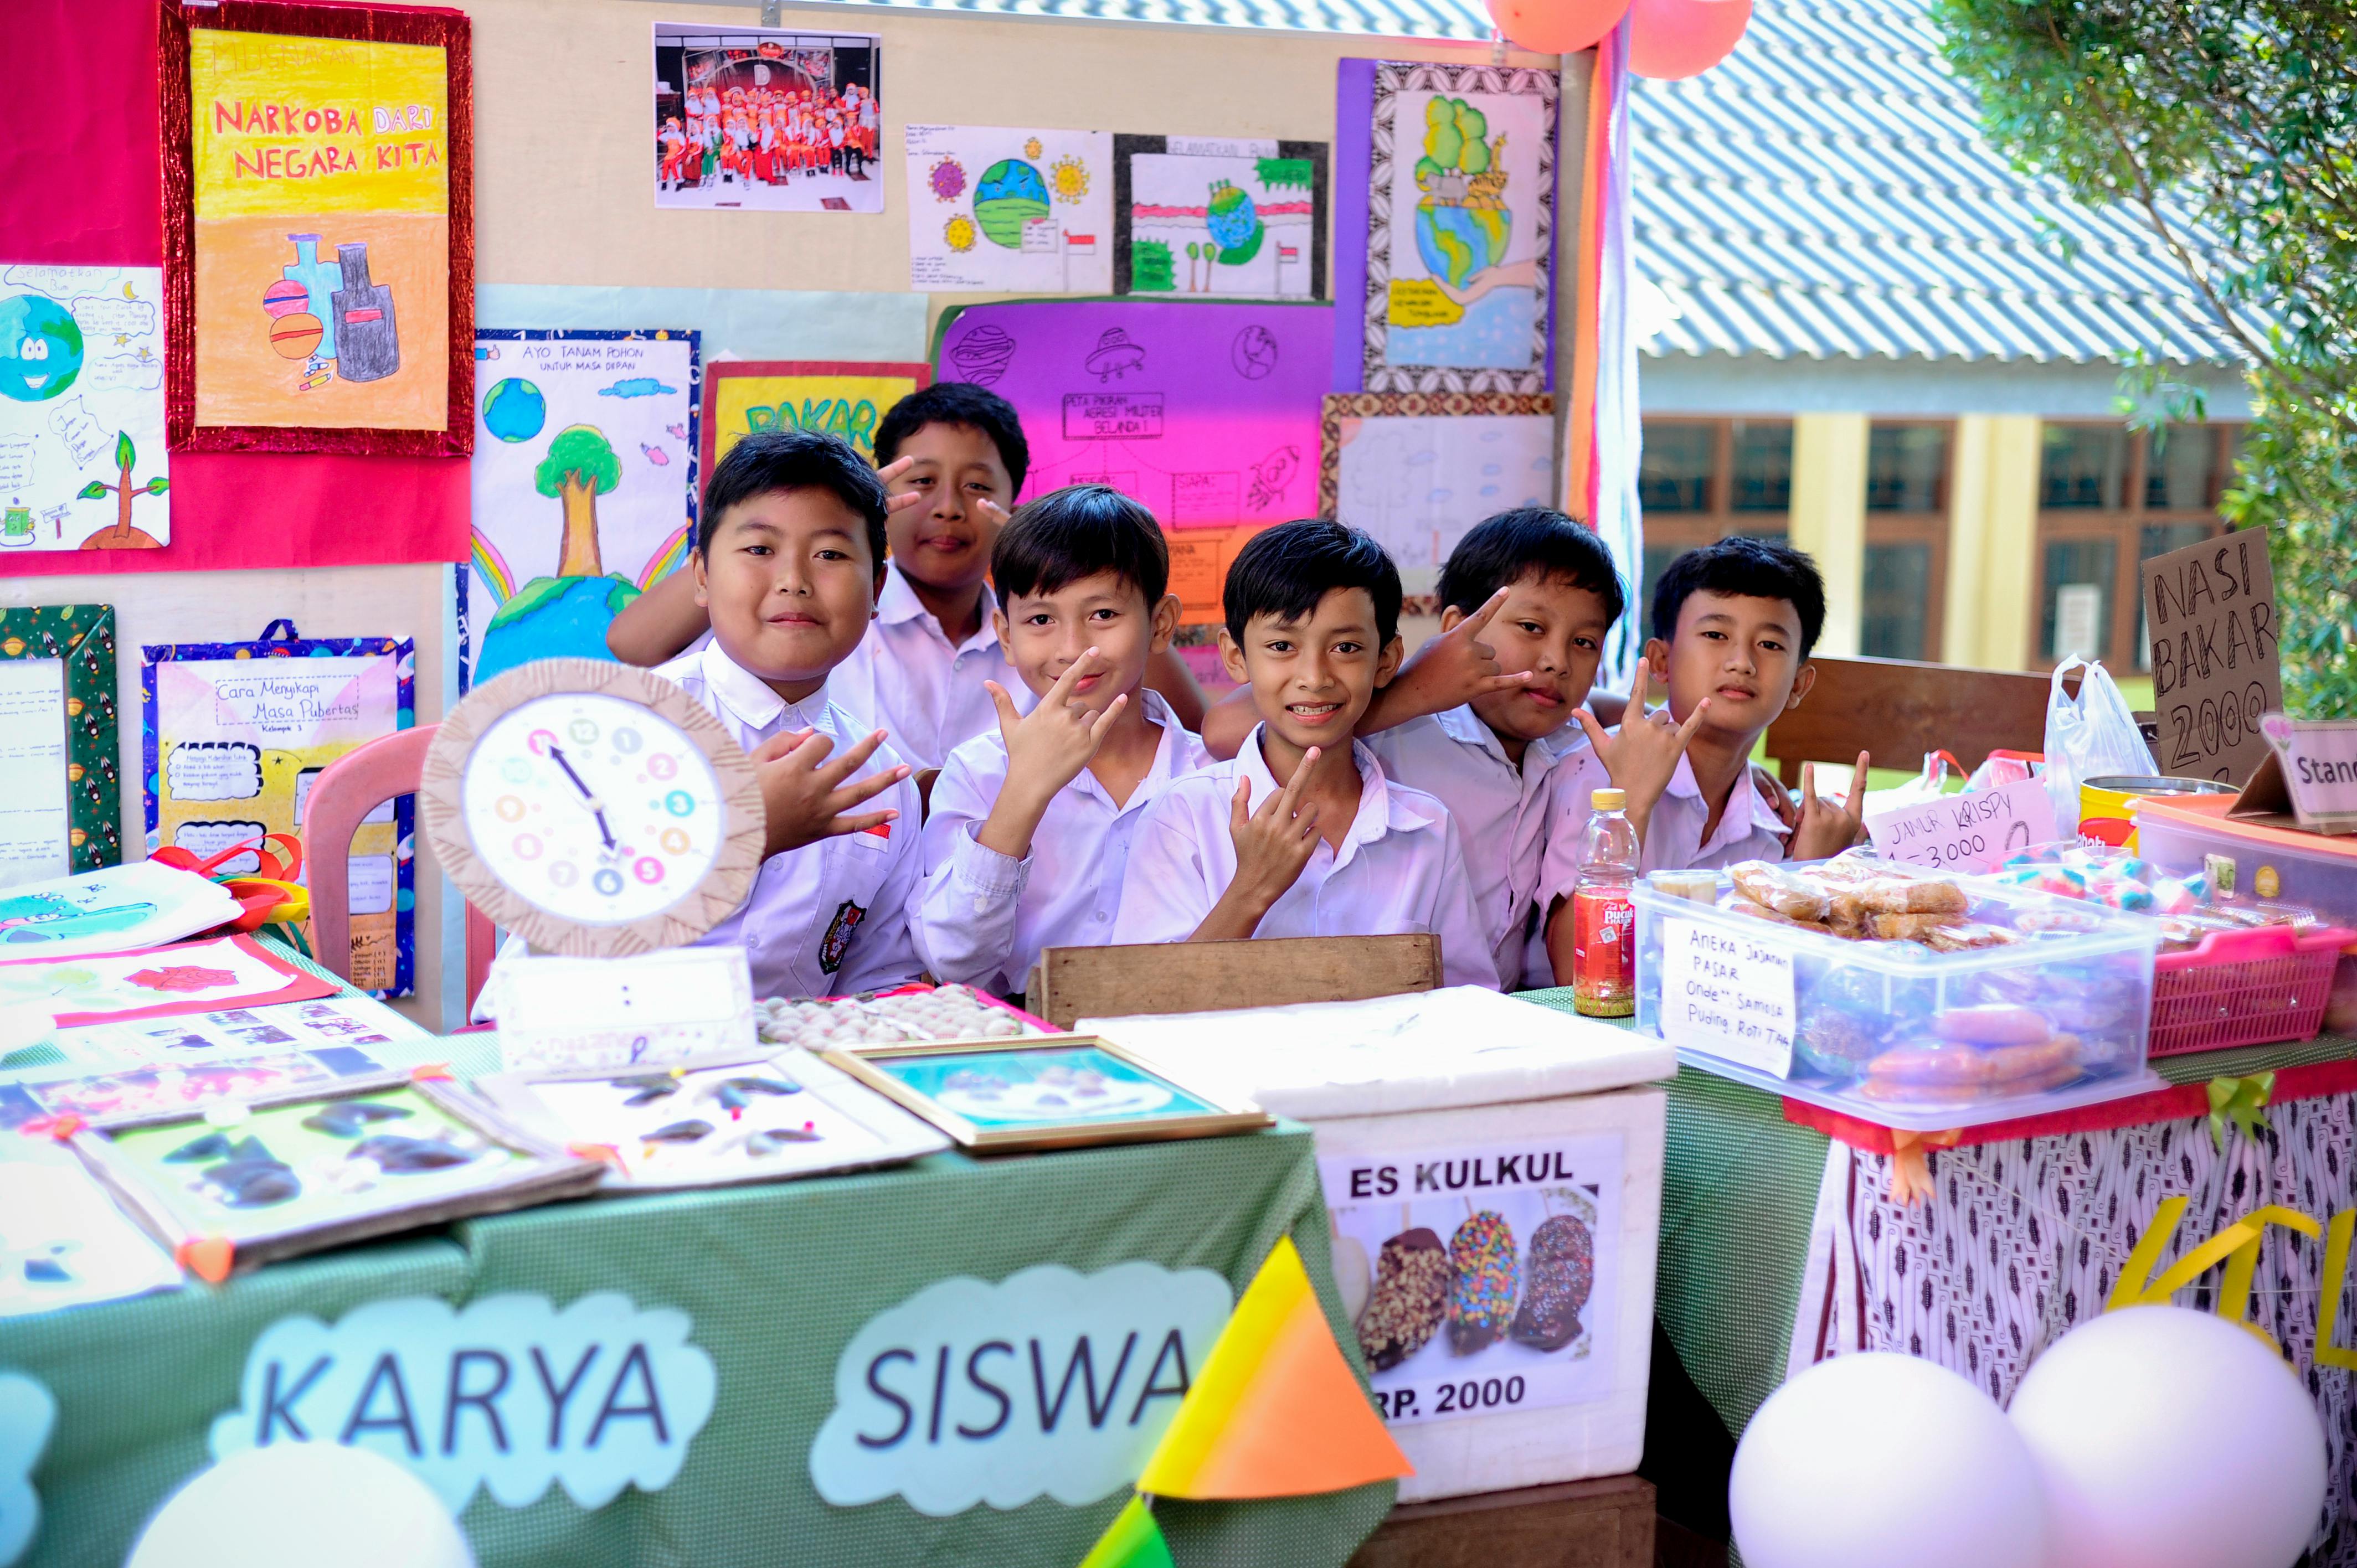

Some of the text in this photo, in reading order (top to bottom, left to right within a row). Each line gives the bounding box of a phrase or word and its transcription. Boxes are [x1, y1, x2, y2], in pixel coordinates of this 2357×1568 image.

[215, 100, 431, 135] NARKOBA DARI
[234, 142, 439, 179] NEGARA KITA
[17, 267, 102, 279] Selamatkan
[522, 345, 644, 359] AYO TANAM POHON
[540, 361, 636, 372] UNTUK MASA DEPAN
[2154, 542, 2251, 625] NASI
[2153, 602, 2278, 698] BAKAR
[217, 680, 320, 700] Cara Menyikapi
[253, 699, 357, 720] Masa Pubertas
[655, 758, 669, 774] 2
[2297, 754, 2357, 784] Stan
[673, 795, 688, 813] 3
[1888, 792, 2012, 845] JAMUR KRISPY
[666, 832, 683, 849] 4
[601, 873, 616, 891] 6
[641, 863, 657, 880] 5
[1604, 907, 1634, 924] pucuk
[1694, 955, 1740, 981] PASAR
[1350, 1151, 1573, 1199] ES KULKUL
[856, 1327, 1191, 1449] SISWA
[1434, 1375, 1526, 1414] 2000
[255, 1342, 672, 1459] KARYA
